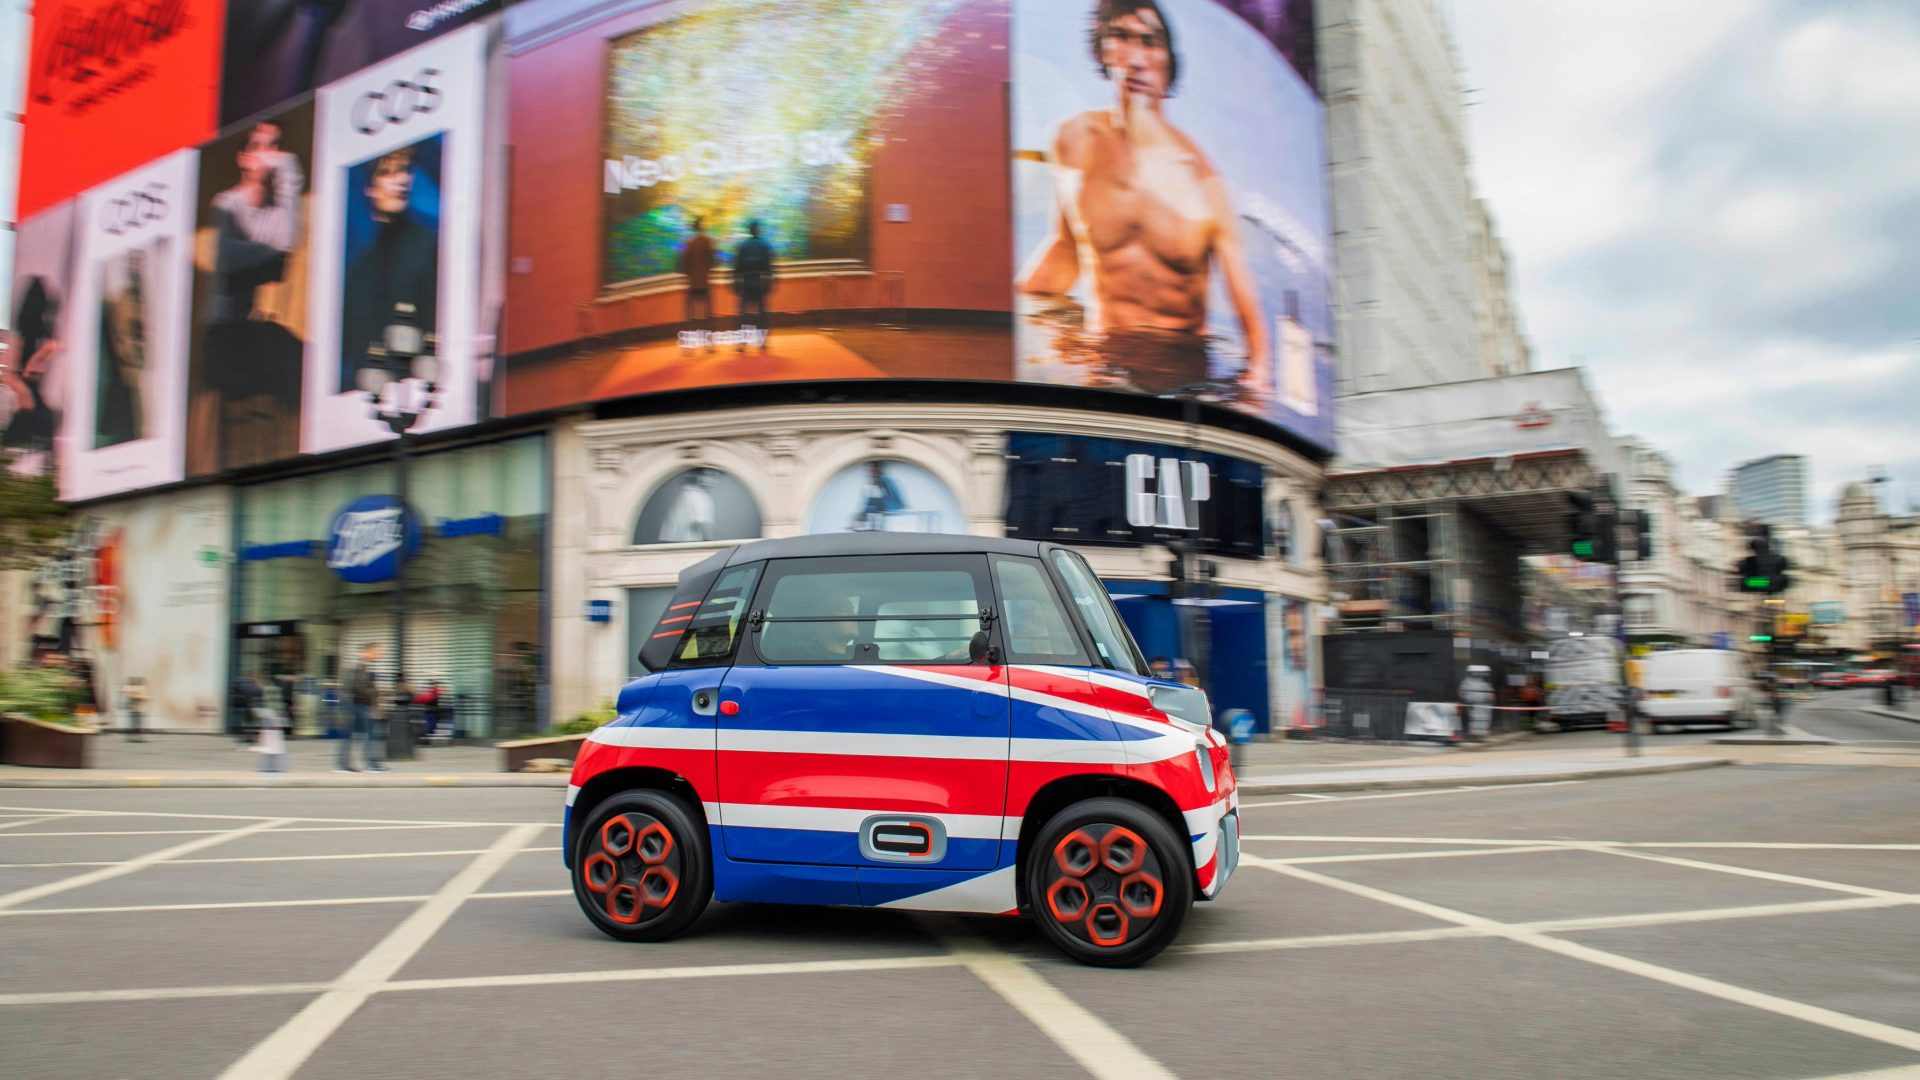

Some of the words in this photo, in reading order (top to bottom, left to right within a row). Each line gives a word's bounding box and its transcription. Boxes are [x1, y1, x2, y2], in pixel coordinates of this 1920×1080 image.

[350, 67, 443, 136] COS
[603, 154, 684, 194] Neo
[99, 182, 170, 236] COS
[1126, 454, 1210, 530] GAP
